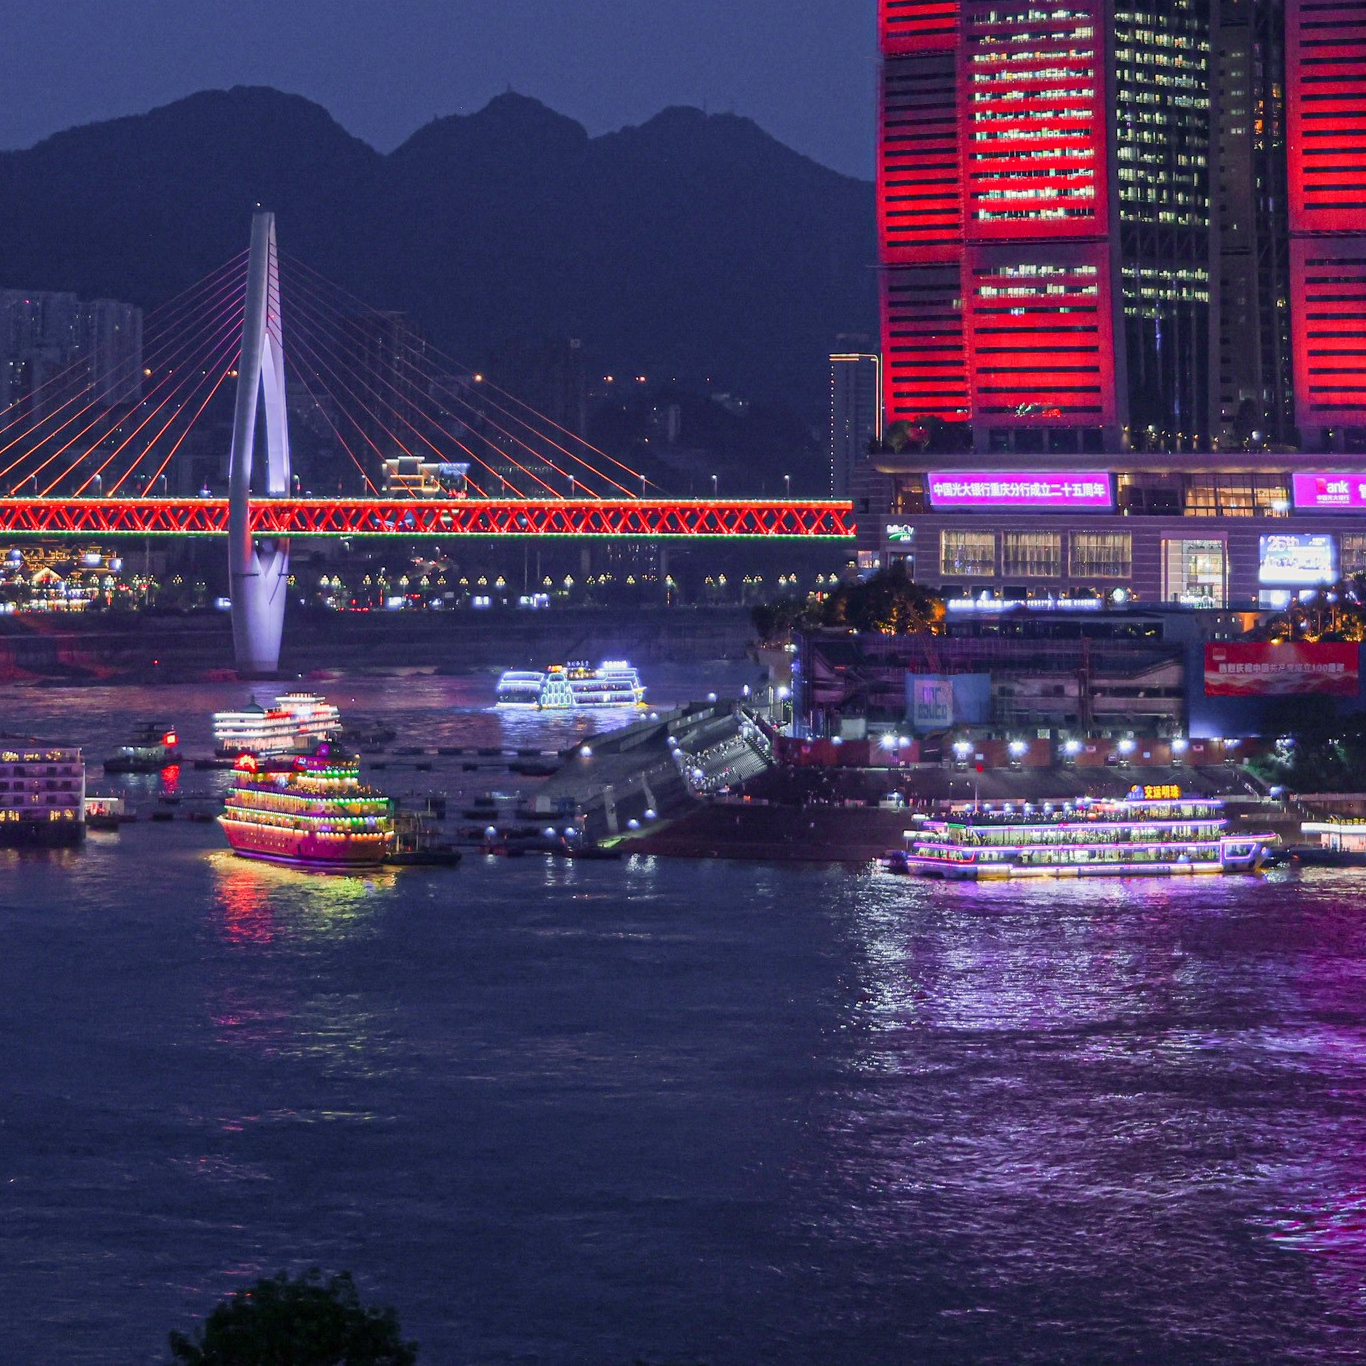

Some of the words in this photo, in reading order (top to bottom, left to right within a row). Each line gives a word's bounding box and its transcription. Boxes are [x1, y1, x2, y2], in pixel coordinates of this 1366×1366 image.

[933, 482, 1106, 498] 中国光大银行重庆分行成立二十五周年
[1144, 784, 1180, 800] 交运明珠
